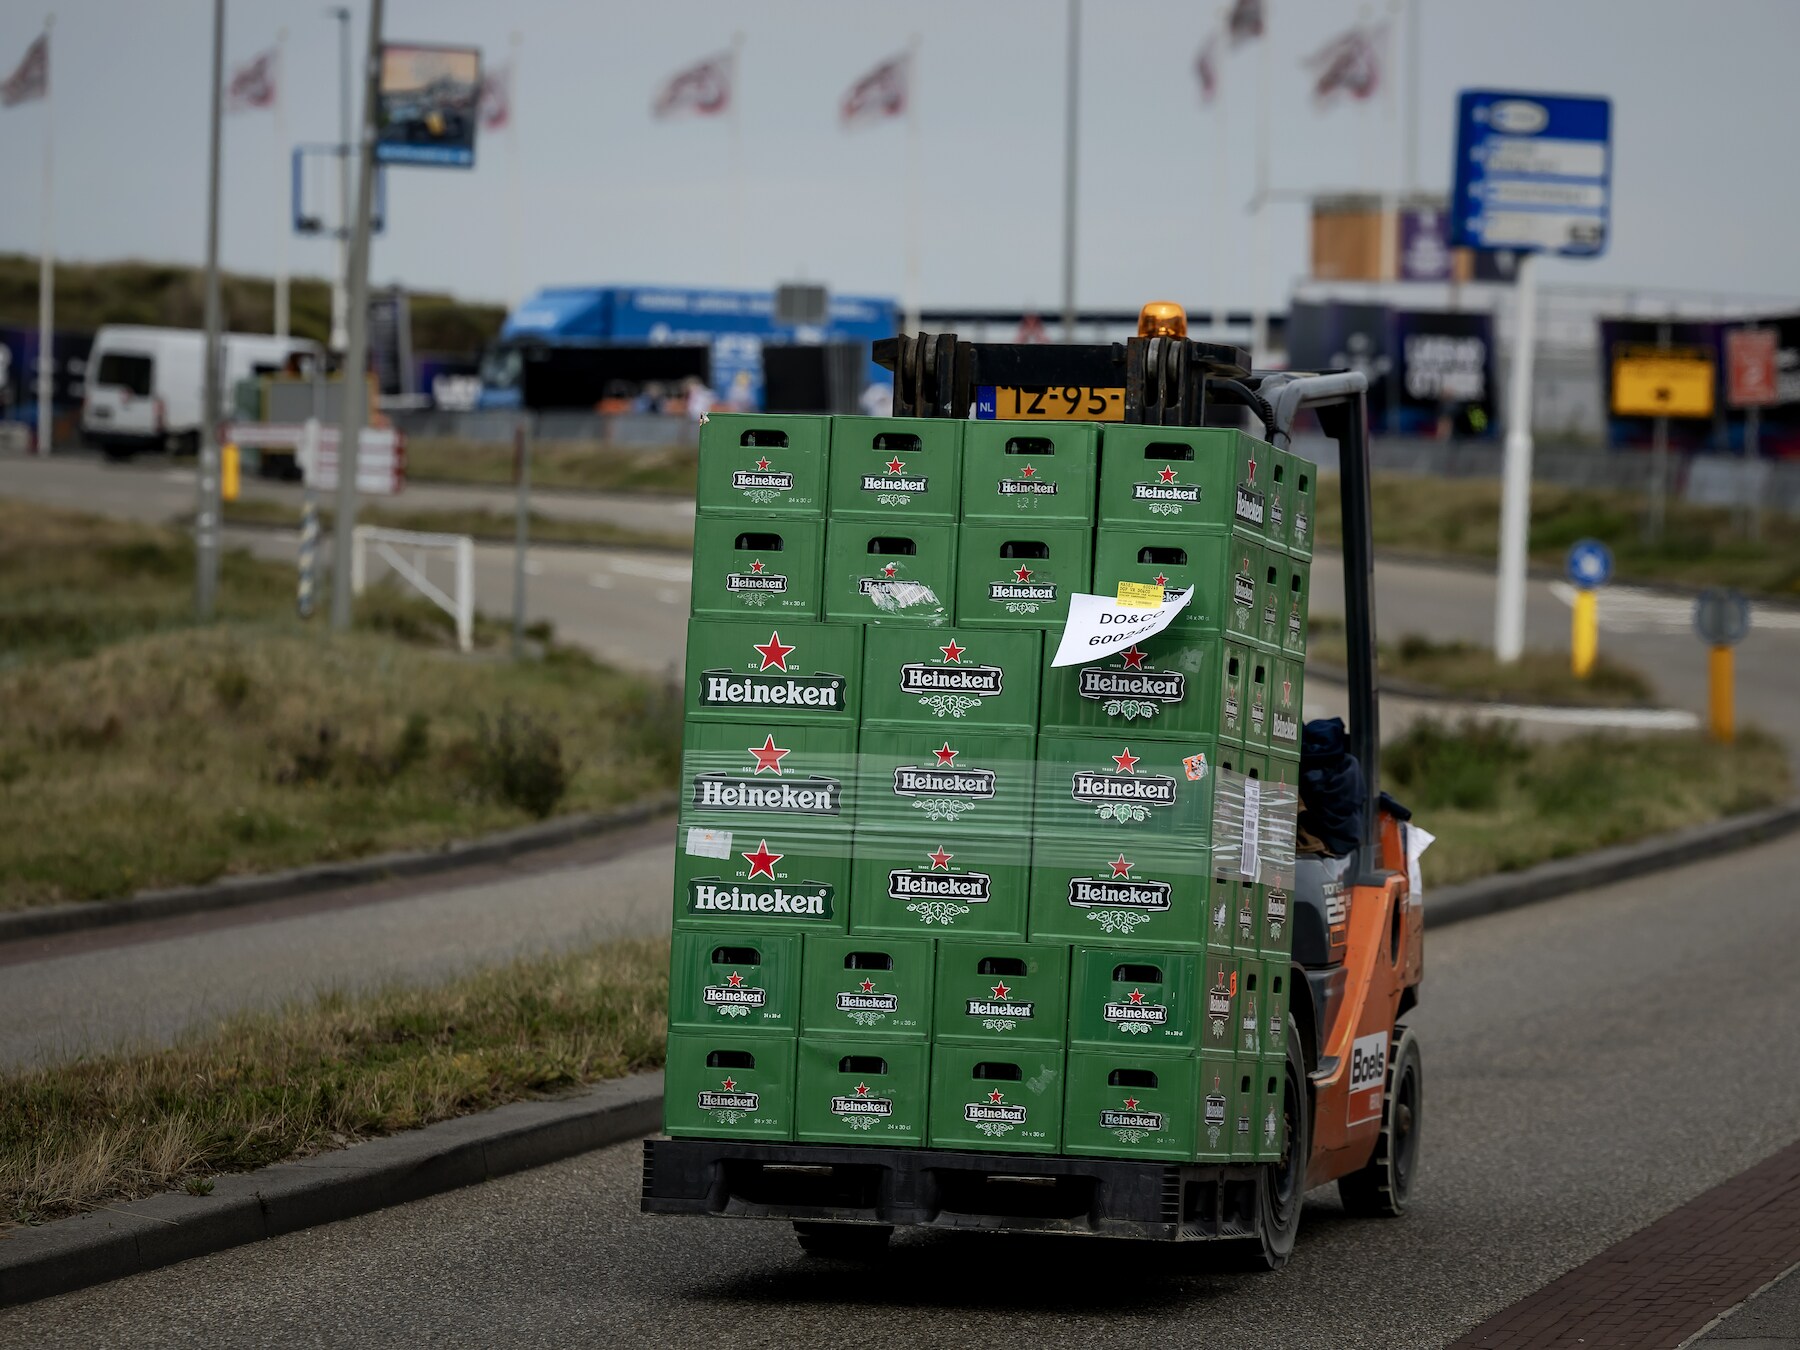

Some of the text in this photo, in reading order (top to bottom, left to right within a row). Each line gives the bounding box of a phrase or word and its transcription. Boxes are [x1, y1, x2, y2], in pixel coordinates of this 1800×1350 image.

[980, 402, 993, 412] NL
[737, 474, 789, 487] Heineken
[863, 478, 925, 491] Heineken
[1002, 482, 1055, 495] Heineken
[1135, 486, 1197, 501] Heineken
[1237, 491, 1263, 524] Heineken
[731, 577, 783, 589] Heineken
[992, 586, 1054, 600] Heineken
[1100, 610, 1165, 624] DO&CO
[908, 670, 994, 689] Heineken
[1085, 674, 1178, 695] Heineken
[707, 678, 837, 706] Heineken
[901, 773, 989, 791] Heineken
[1077, 778, 1170, 799] Heineken
[702, 782, 833, 809] Heineken
[896, 876, 983, 895] Heineken
[695, 886, 825, 914] Heineken
[1077, 884, 1164, 904] Heineken
[706, 990, 761, 1003] Heineken
[841, 996, 893, 1009] Heineken
[969, 1002, 1031, 1016] Heineken
[1108, 1007, 1163, 1020] Heineken
[1352, 1043, 1384, 1084] Boels
[702, 1095, 755, 1107] Heineken
[835, 1101, 888, 1113] Heineken
[969, 1108, 1022, 1120] Heineken
[1104, 1114, 1157, 1127] Heineken
